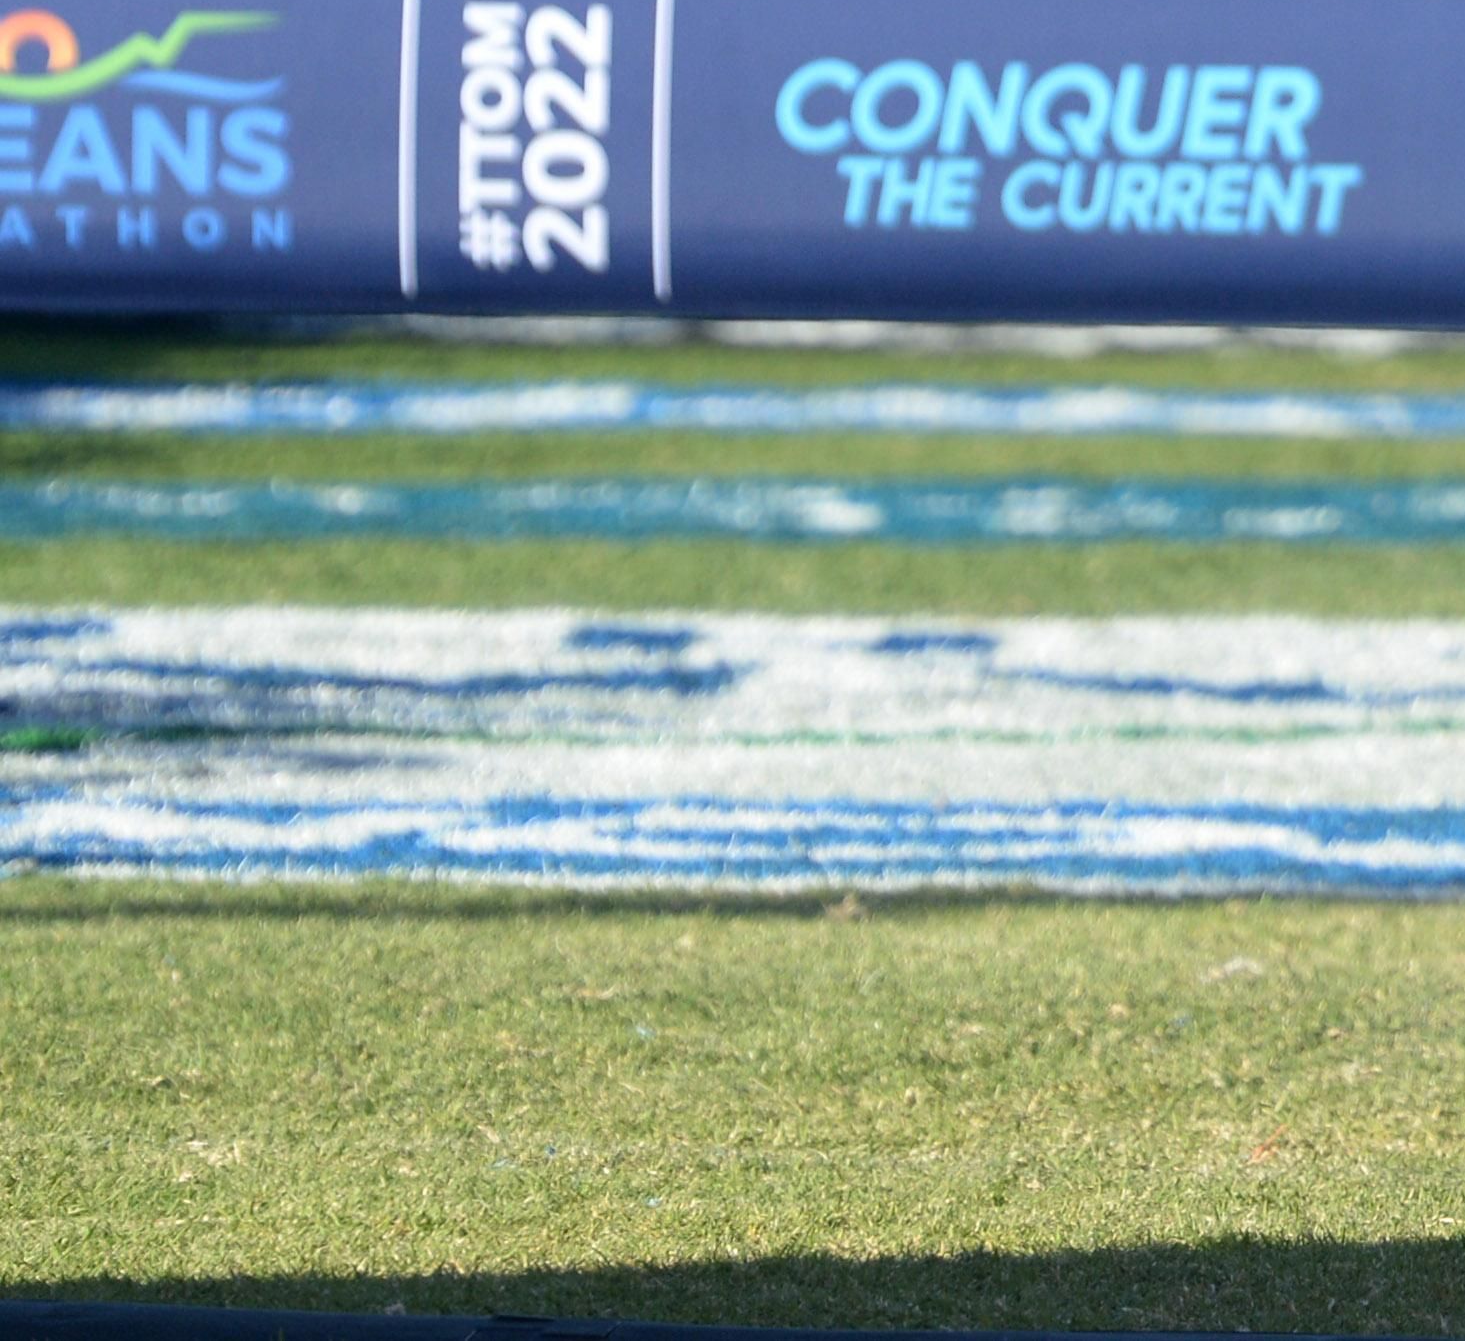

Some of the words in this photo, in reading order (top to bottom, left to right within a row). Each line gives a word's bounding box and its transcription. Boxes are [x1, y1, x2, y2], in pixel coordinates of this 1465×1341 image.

[460, 2, 521, 270] #TTOM
[522, 4, 611, 271] 2022
[776, 58, 1322, 157] CONQUER
[0, 207, 292, 250] ATHON
[837, 156, 981, 228] THE
[1001, 161, 1361, 235] CURRENT
